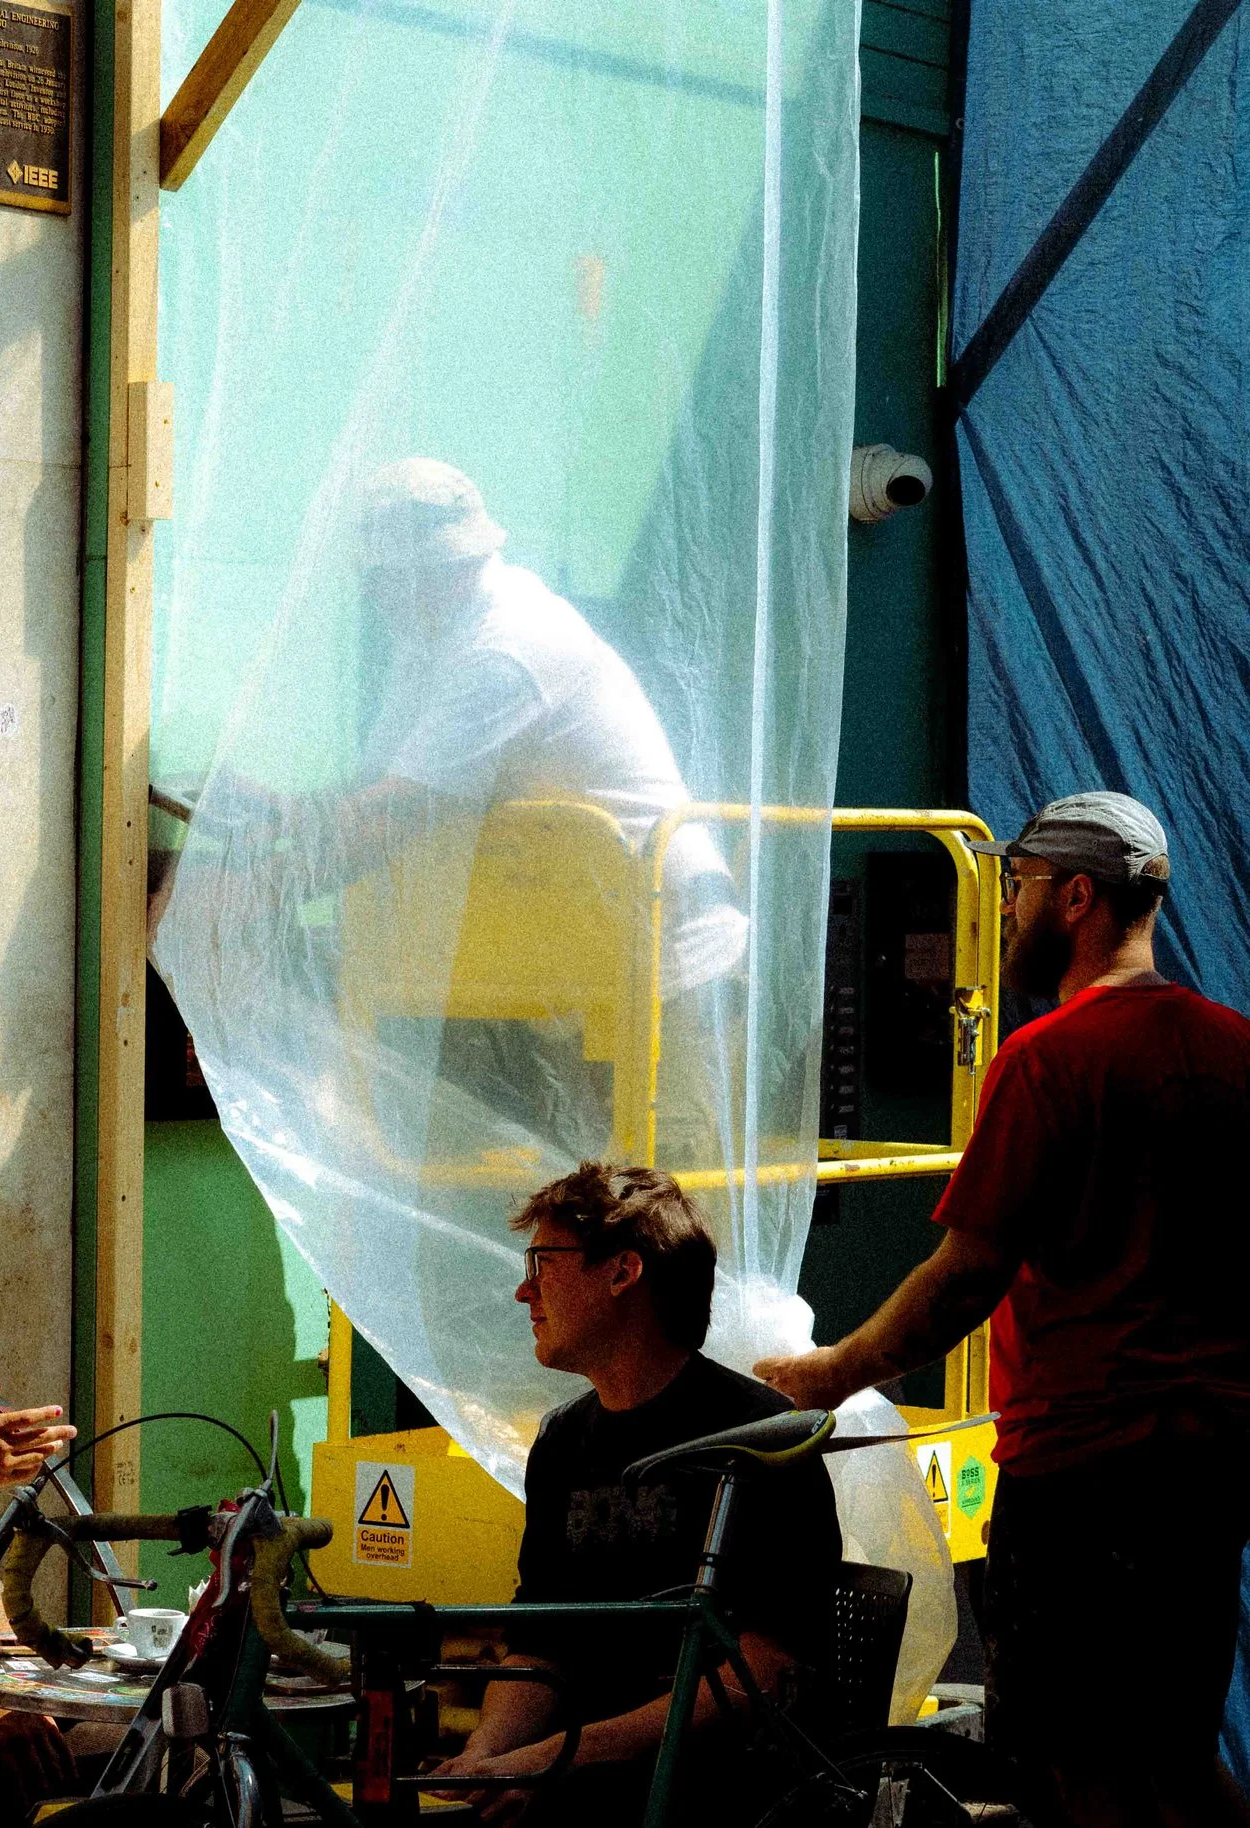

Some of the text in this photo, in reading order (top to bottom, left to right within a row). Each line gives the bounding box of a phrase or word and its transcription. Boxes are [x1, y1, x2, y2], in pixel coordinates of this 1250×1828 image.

[11, 11, 59, 30] ENGINEERING
[23, 164, 59, 189] IEEE
[361, 1530, 404, 1545] Caution
[361, 1544, 405, 1556] Men working
[366, 1552, 399, 1561] overhead
